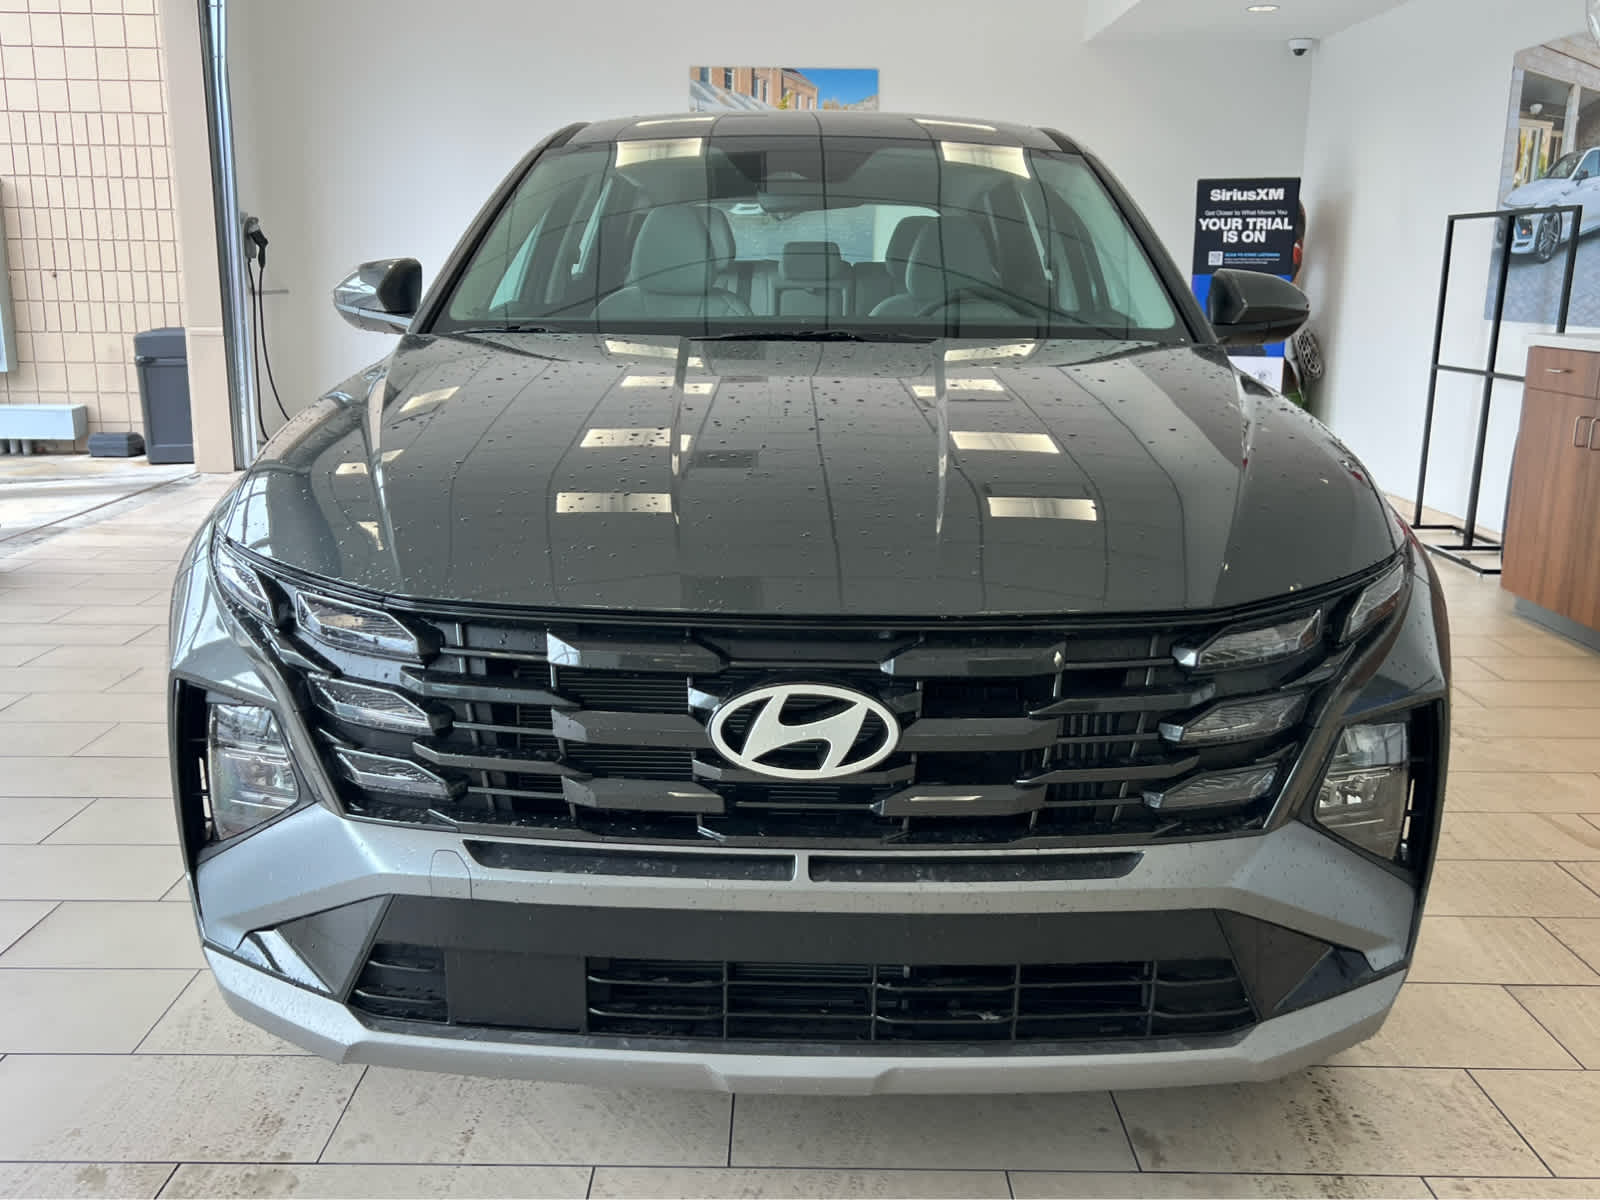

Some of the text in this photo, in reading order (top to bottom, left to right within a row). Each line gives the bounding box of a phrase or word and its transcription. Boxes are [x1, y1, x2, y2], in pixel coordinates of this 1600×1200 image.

[1210, 188, 1285, 201] SiriusXM
[1199, 217, 1293, 230] YOUR TRIAL
[1223, 231, 1266, 243] IS ON
